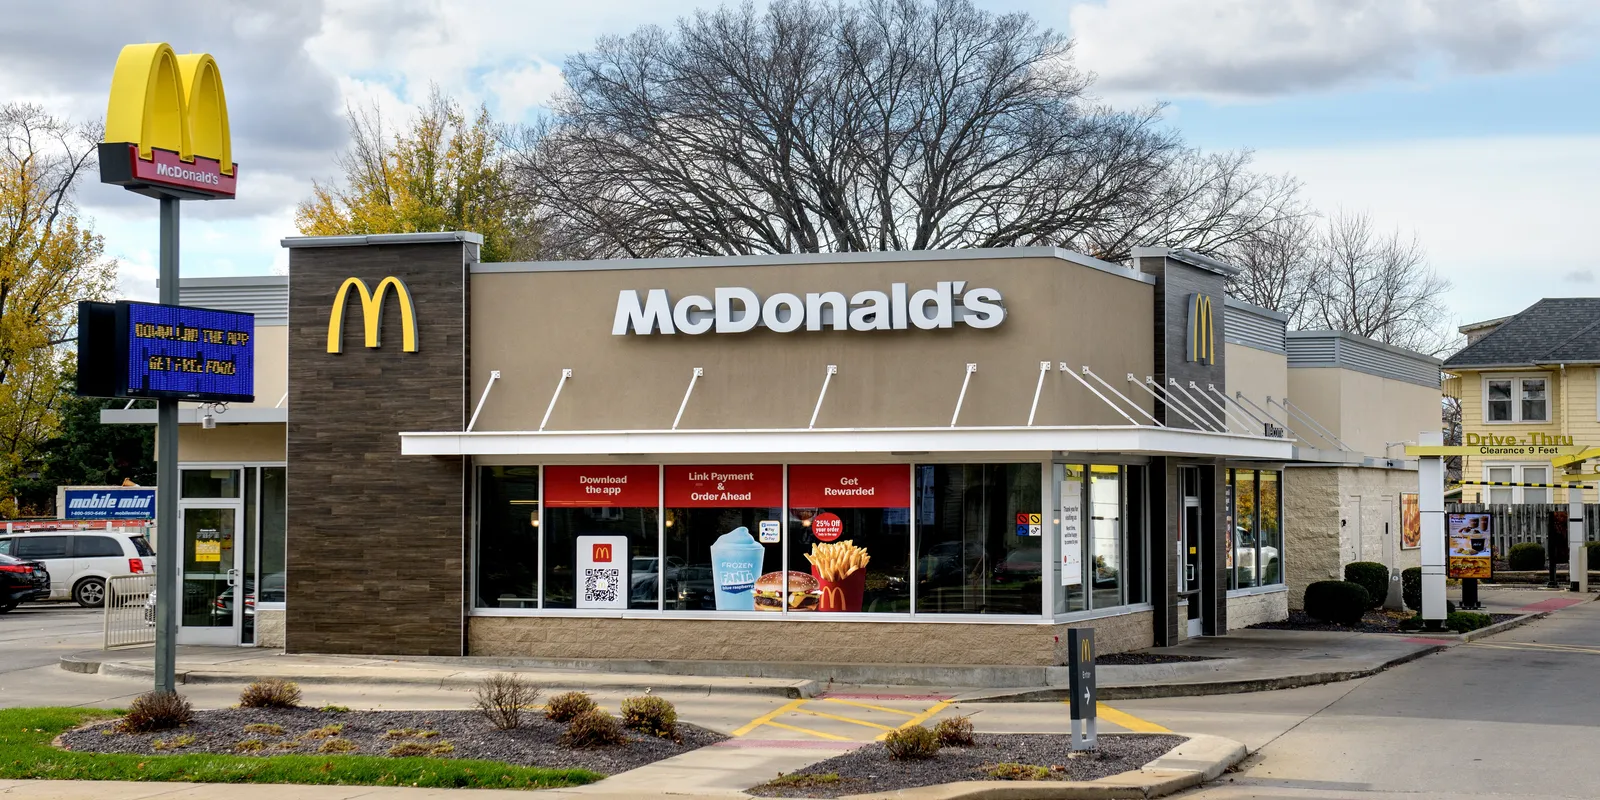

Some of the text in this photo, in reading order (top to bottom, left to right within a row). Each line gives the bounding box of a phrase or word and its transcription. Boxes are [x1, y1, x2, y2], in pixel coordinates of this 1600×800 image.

[156, 162, 219, 185] McDonald's
[611, 281, 1005, 335] McDonald's
[202, 329, 224, 344] THE
[226, 331, 249, 346] APP
[1480, 446, 1525, 454] Clearance
[1538, 446, 1558, 454] Feet
[580, 475, 627, 484] Download
[688, 472, 754, 482] Link Payment
[840, 477, 859, 486] Get
[585, 485, 621, 496] the app
[717, 482, 725, 491] &
[824, 487, 875, 496] Rewarded
[69, 494, 151, 508] mobile mini
[691, 492, 751, 501] Order Ahead
[831, 519, 841, 527] Off
[1030, 514, 1040, 524] 0
